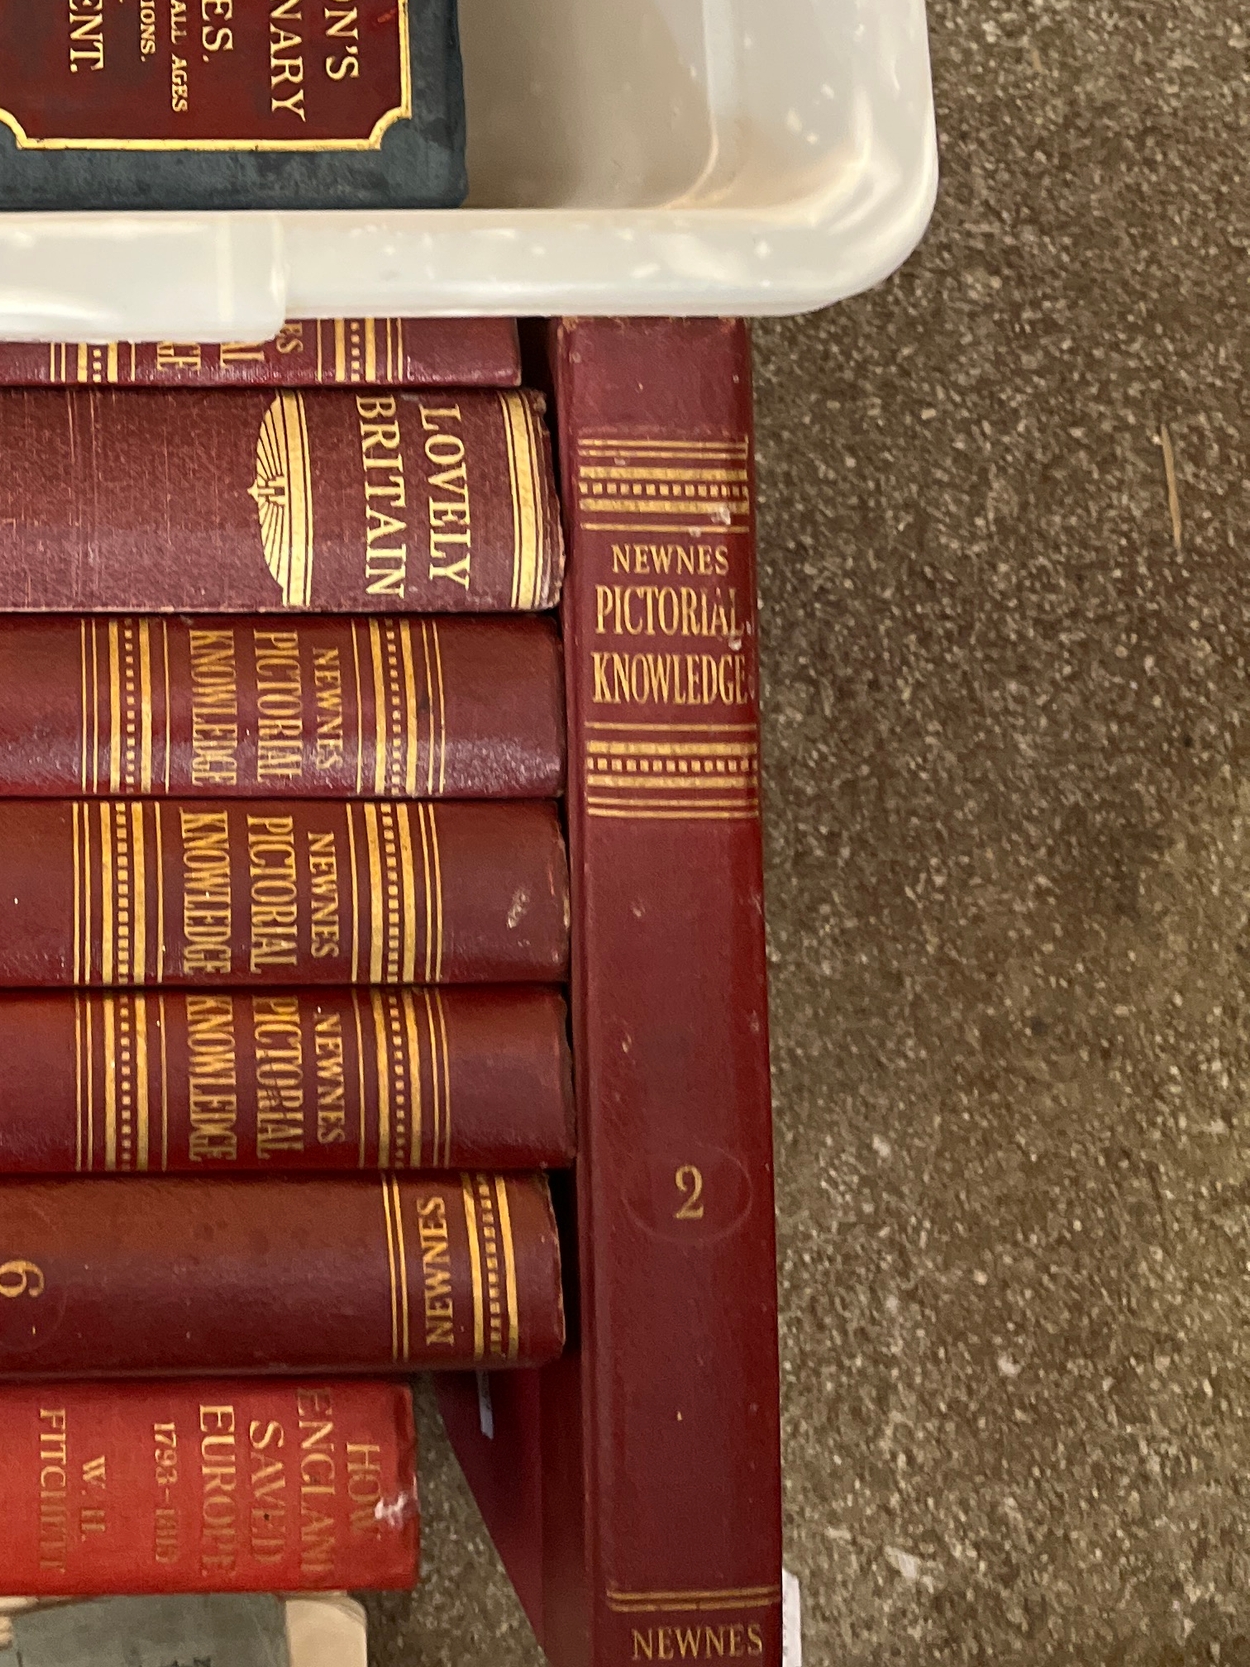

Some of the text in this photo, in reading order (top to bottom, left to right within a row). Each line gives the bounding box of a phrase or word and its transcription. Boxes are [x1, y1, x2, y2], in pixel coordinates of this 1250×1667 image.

[169, 53, 189, 113] AGES
[354, 394, 408, 600] BRITAIN
[417, 402, 472, 592] LOVELY
[610, 543, 730, 576] NEWNES
[590, 650, 747, 707] KNOWLEDGE
[594, 583, 744, 637] PICTORIAL
[188, 628, 238, 788] KNOWLEDGE
[252, 627, 304, 784] PICTORIAL
[312, 646, 345, 772] NEWNES
[178, 806, 233, 976] KNOWLEDGE
[245, 813, 299, 976] PICTORIAL
[306, 830, 341, 960] NEWNES
[185, 994, 238, 1163] KNOWLEDGE
[251, 994, 306, 1160] PICTORIAL
[313, 1010, 347, 1146] NEWNES
[672, 1163, 706, 1221] 2
[415, 1195, 456, 1348] NEWNES
[81, 1454, 107, 1496] W.
[249, 1420, 287, 1564] SAVED
[296, 1386, 336, 1576] ENGLAN
[630, 1622, 765, 1662] NEWNES
